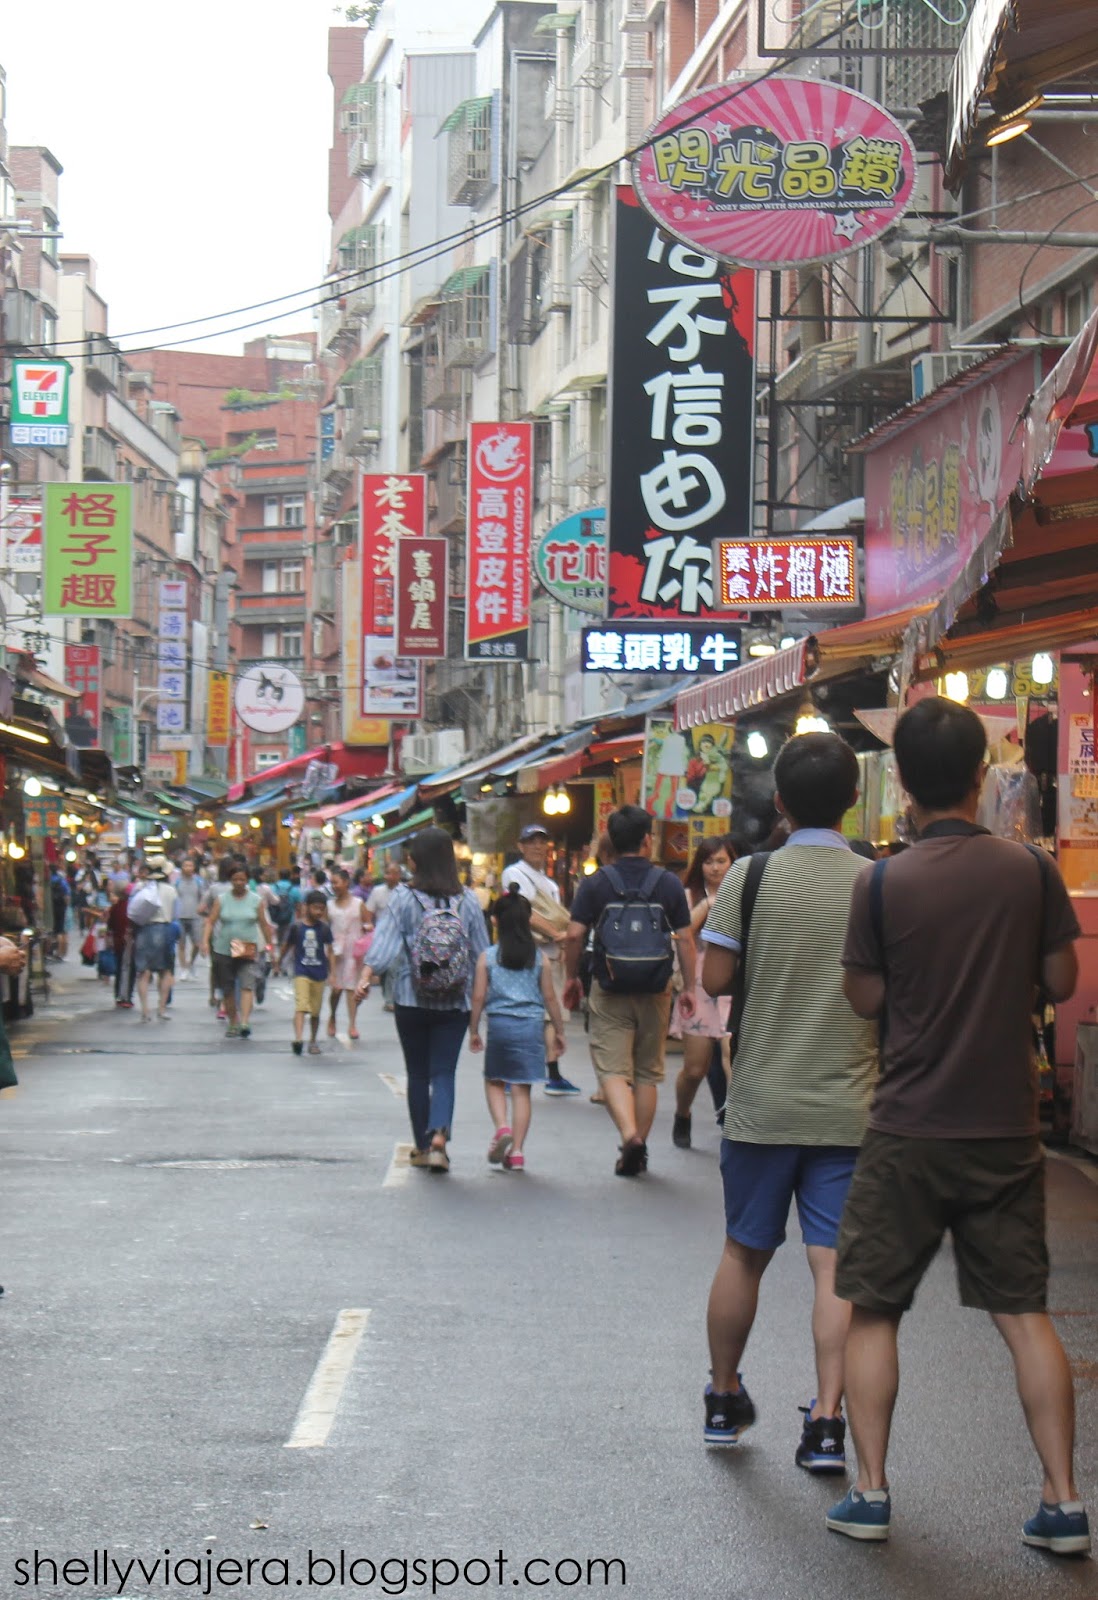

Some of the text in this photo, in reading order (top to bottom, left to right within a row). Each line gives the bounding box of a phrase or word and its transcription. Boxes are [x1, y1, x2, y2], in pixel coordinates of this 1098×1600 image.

[652, 129, 901, 199] 閃光晶鑽
[739, 203, 763, 211] SHOP
[764, 202, 787, 210] WITH
[788, 202, 836, 210] SPARKLING
[838, 200, 895, 209] ACCESSORIES
[60, 492, 117, 608] 格子趣
[475, 487, 508, 624] 高登皮件
[512, 559, 525, 622] LEATHER
[586, 632, 738, 671] 雙頭乳牛
